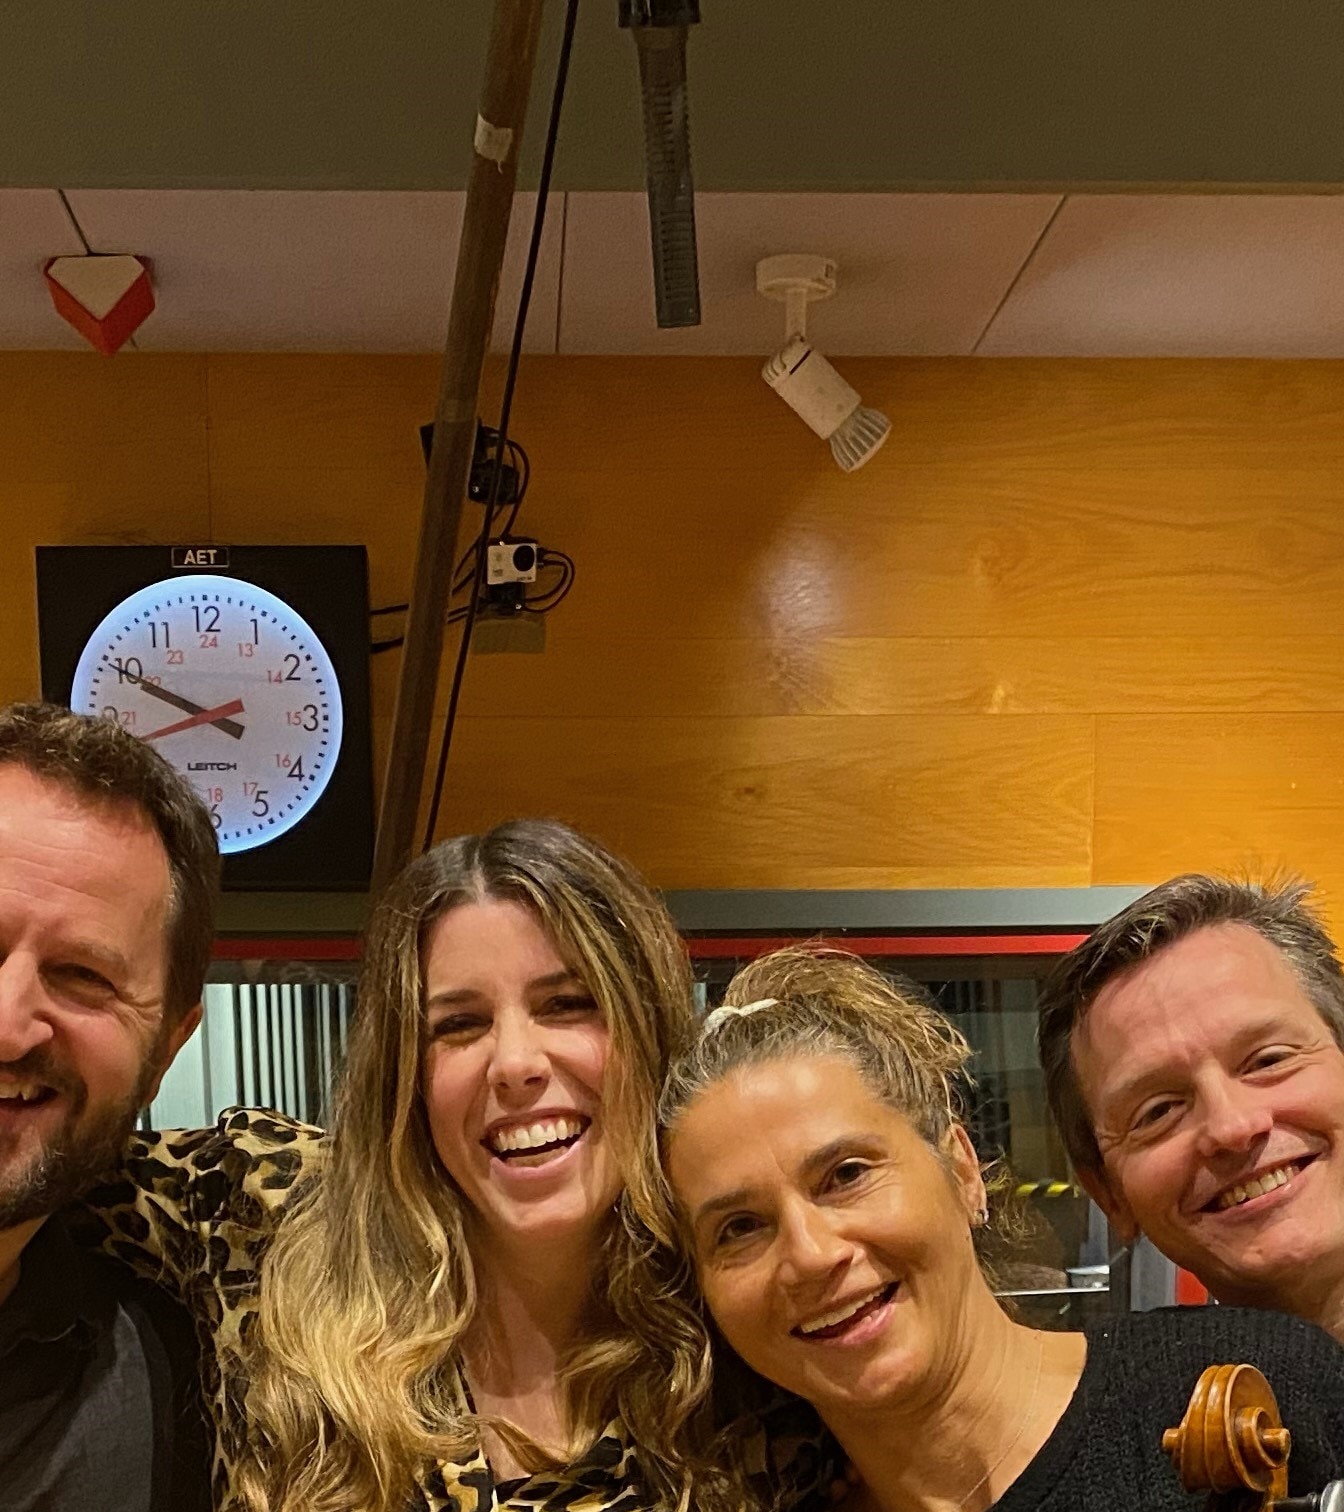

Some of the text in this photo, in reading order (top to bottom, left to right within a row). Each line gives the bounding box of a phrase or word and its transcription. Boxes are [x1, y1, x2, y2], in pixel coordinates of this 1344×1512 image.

[184, 549, 217, 565] AET
[192, 605, 221, 632] 12
[148, 621, 170, 648] 11
[250, 619, 258, 645] 1
[199, 634, 218, 648] 24
[167, 650, 184, 664] 23
[238, 643, 254, 657] 13
[114, 657, 143, 684] 10
[284, 654, 301, 681] 2
[267, 670, 283, 684] 14
[121, 711, 136, 726] 21
[287, 711, 302, 726] 15
[303, 704, 319, 731] 3
[187, 762, 237, 771] LEITCH
[275, 753, 291, 768] 16
[287, 755, 305, 782] 4
[207, 787, 223, 803] 18
[243, 782, 258, 797] 17
[252, 790, 269, 817] 5
